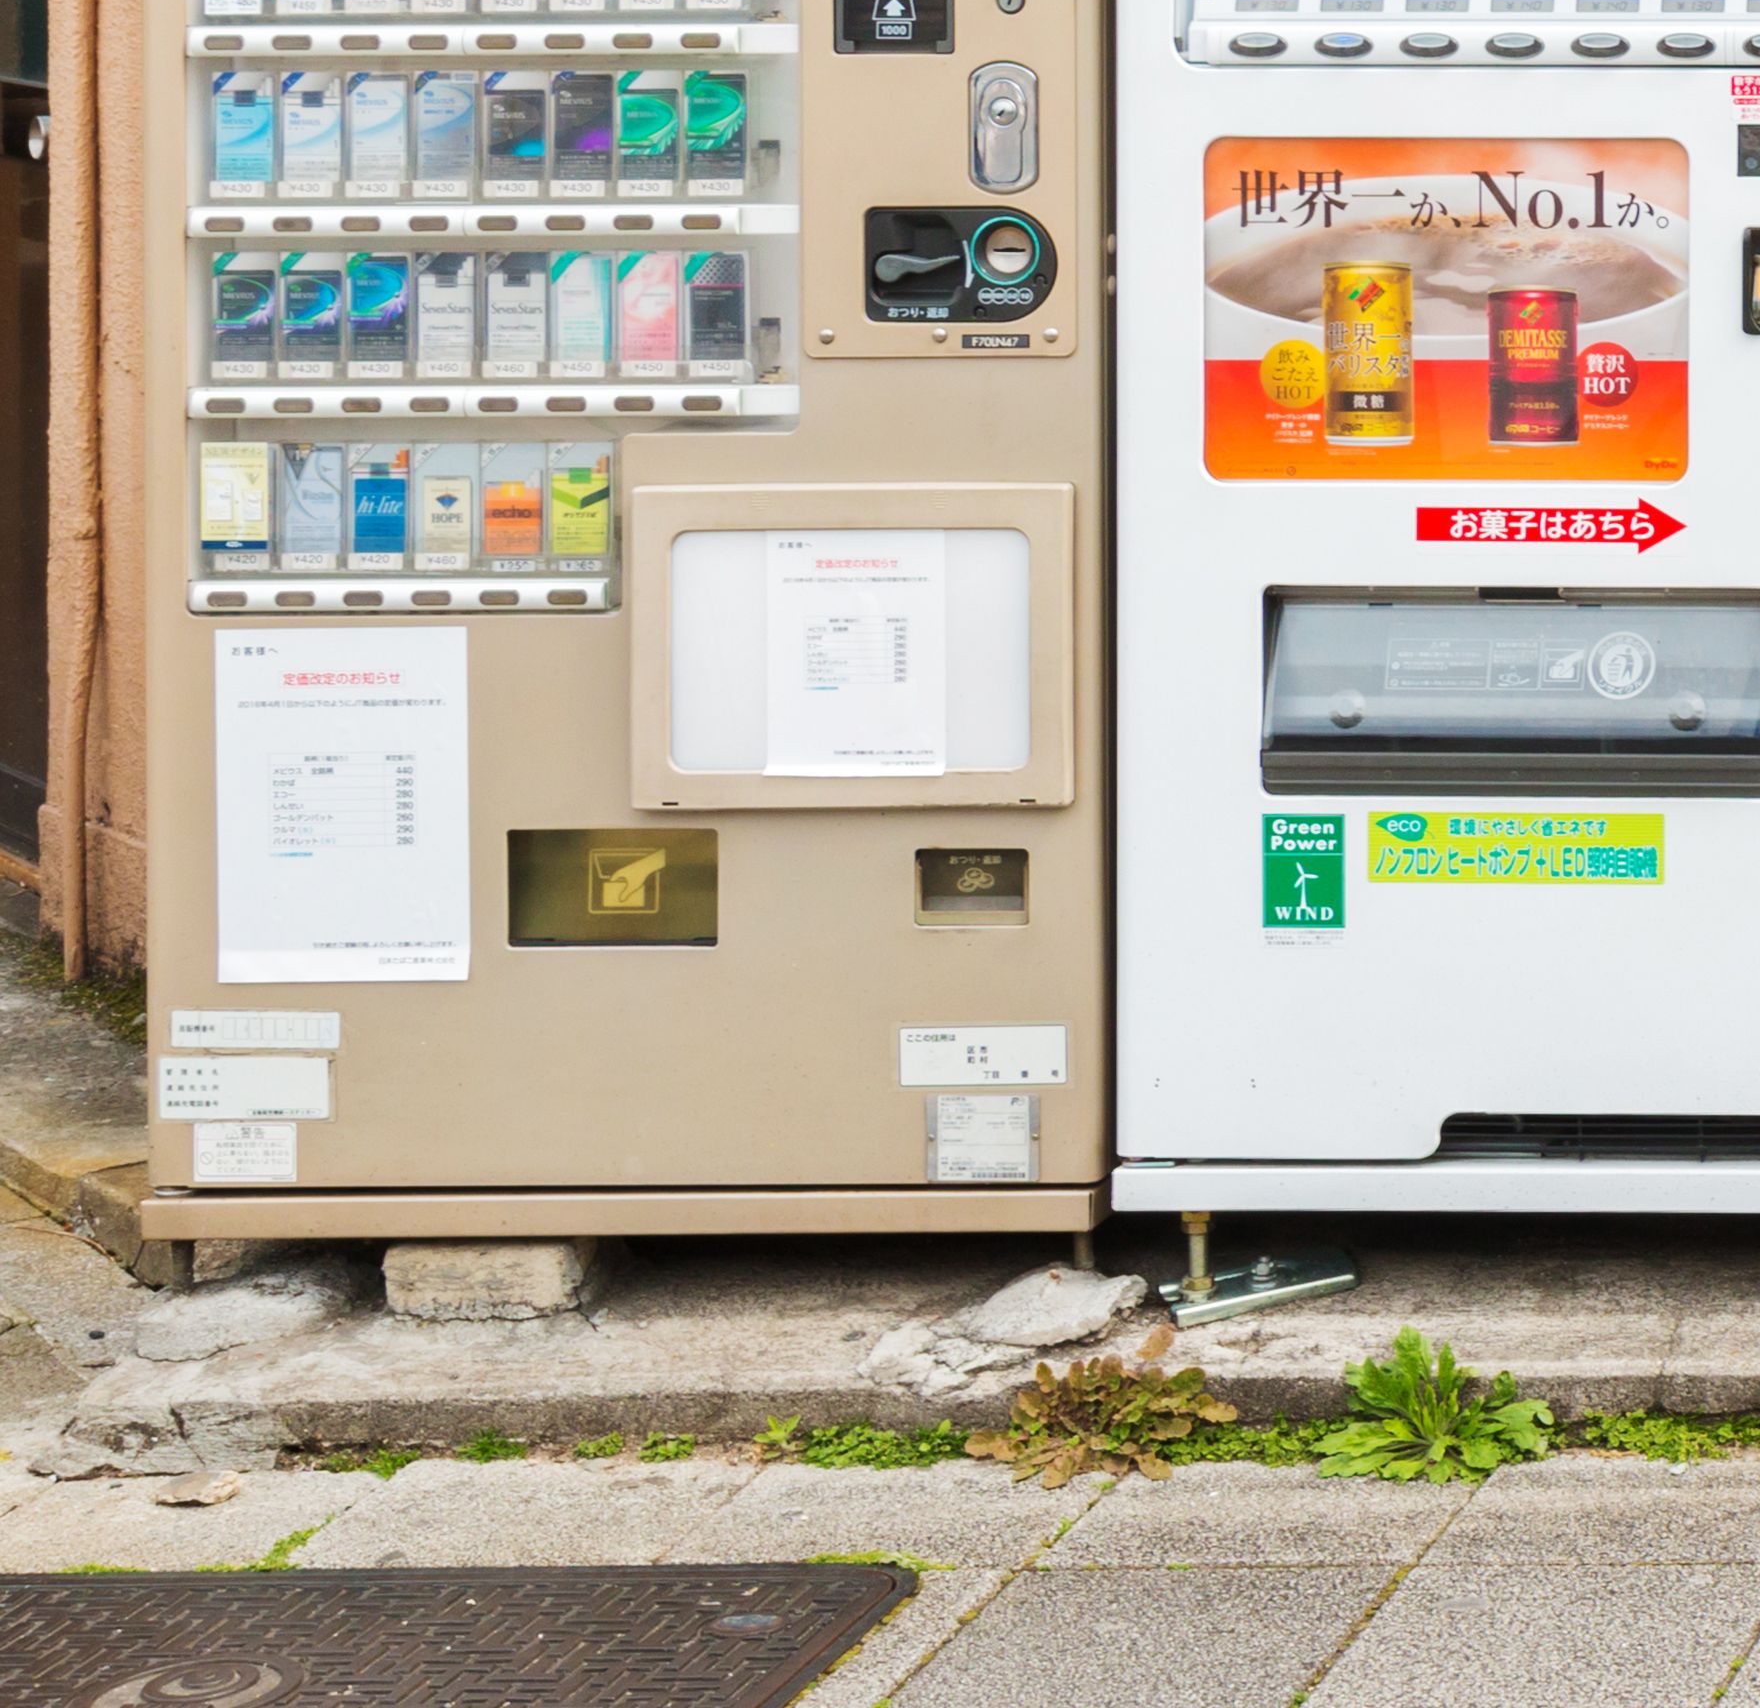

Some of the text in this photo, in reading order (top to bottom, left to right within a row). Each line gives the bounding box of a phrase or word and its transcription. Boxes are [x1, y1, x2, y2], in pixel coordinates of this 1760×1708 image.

[1583, 375, 1631, 394] HOT
[431, 511, 463, 524] HOPE
[1449, 511, 1655, 541] お菓子はあちら
[1271, 818, 1335, 836] Green
[1387, 818, 1421, 833] eco
[1270, 835, 1337, 852] Power
[1275, 906, 1335, 922] WIND
